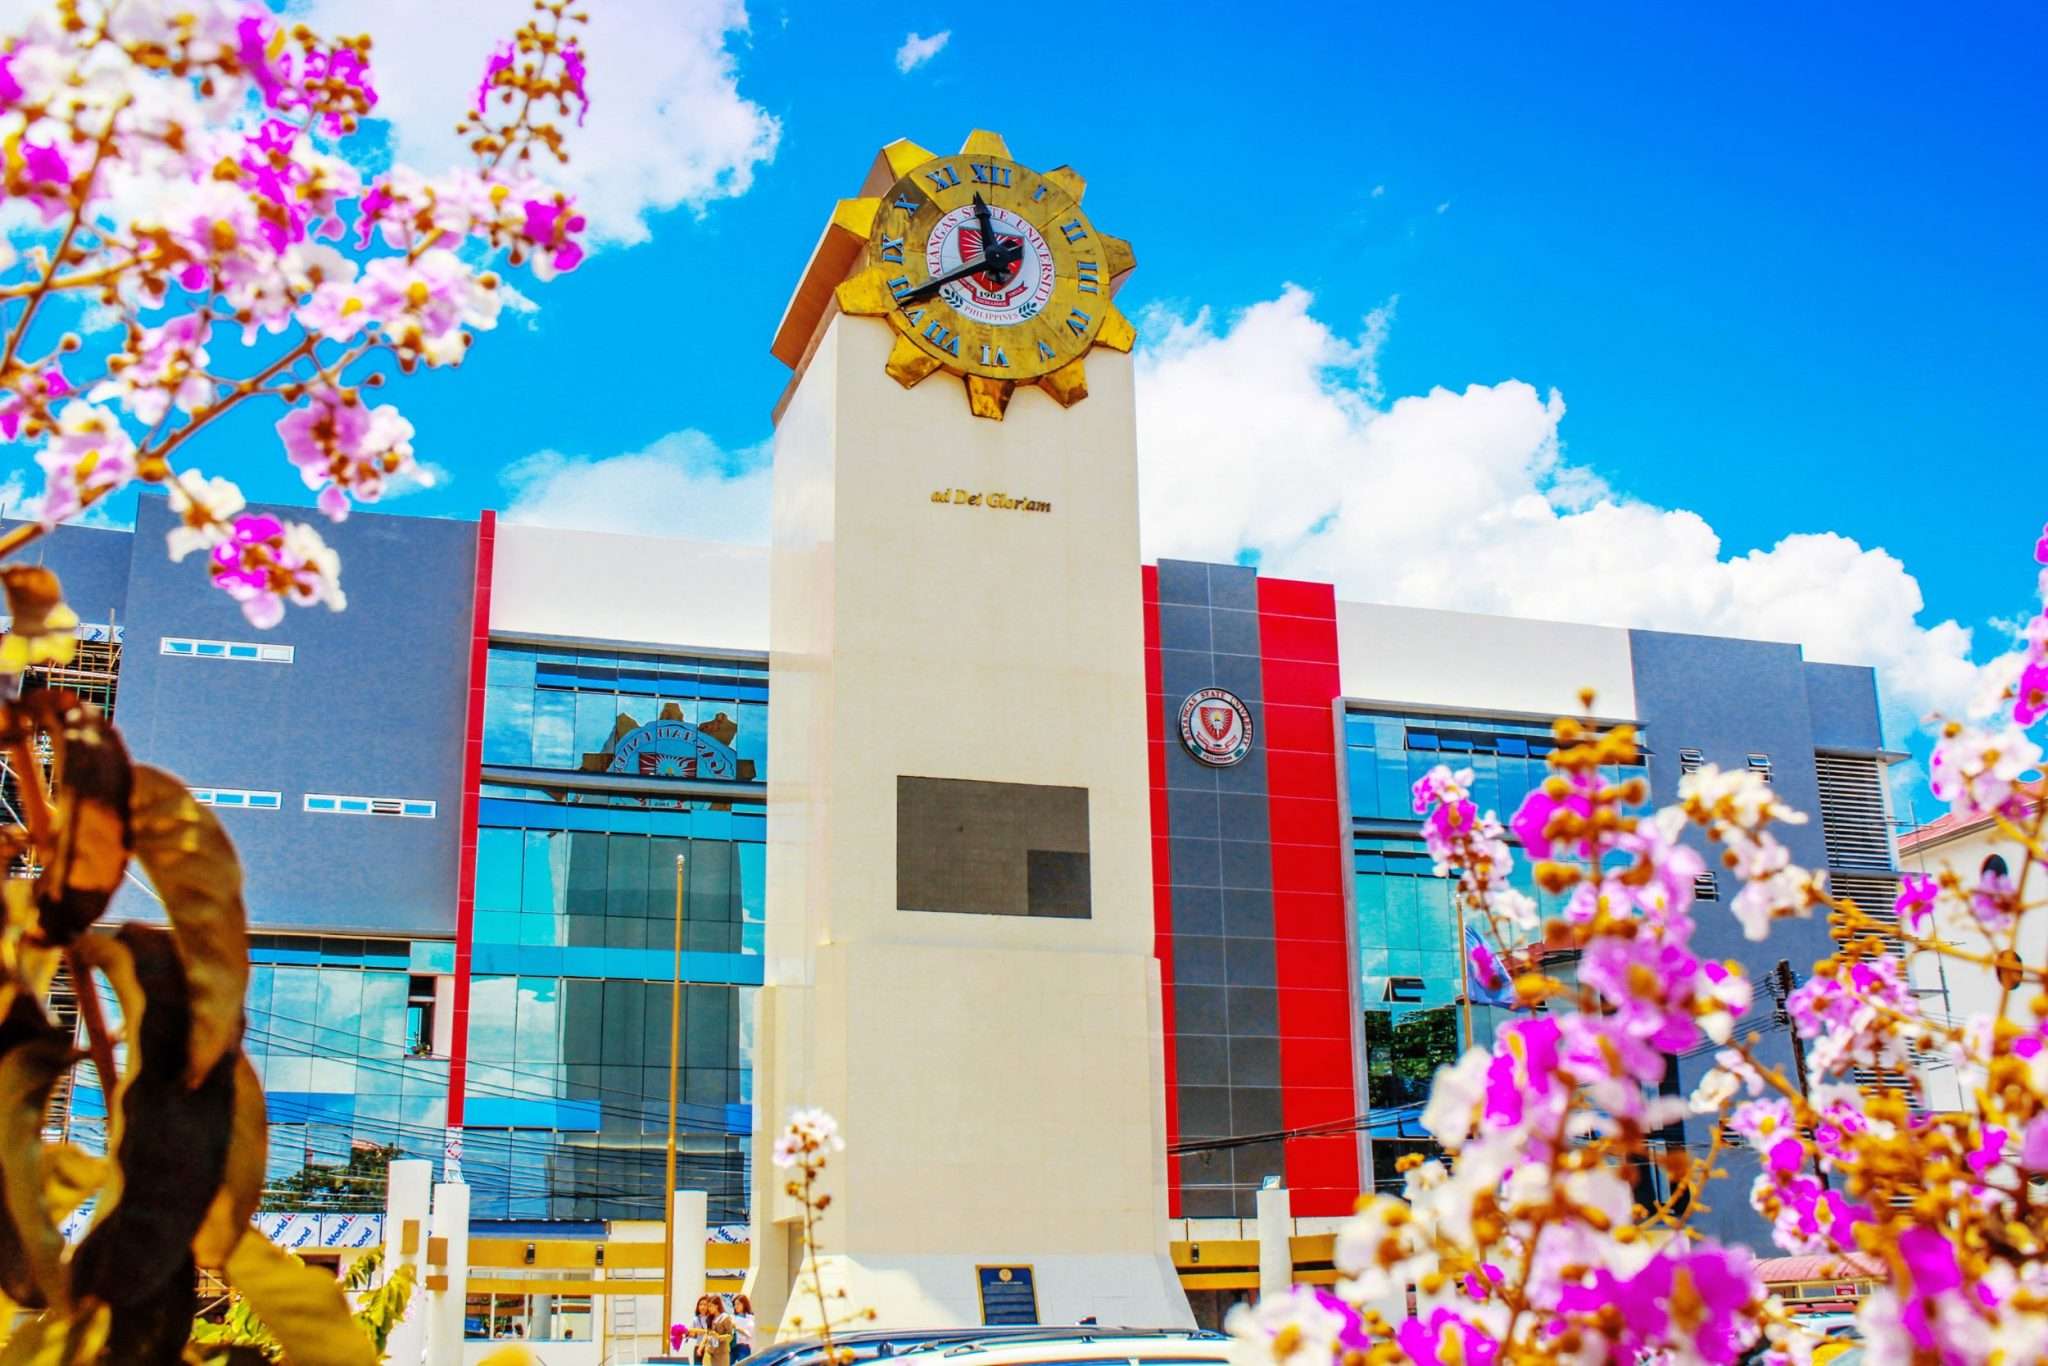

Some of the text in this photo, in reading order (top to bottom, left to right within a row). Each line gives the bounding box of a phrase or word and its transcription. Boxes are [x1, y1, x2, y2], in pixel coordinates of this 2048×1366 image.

[926, 165, 960, 192] XI
[970, 163, 1012, 188] XII
[894, 193, 920, 217] X
[1060, 218, 1088, 246] II
[881, 232, 905, 265] IX
[929, 213, 958, 277] ATANGAS
[1015, 219, 1052, 304] UNIVERSITY
[1077, 261, 1098, 295] III
[964, 305, 1019, 321] PHILIPPINES
[930, 488, 1051, 513] ad Dei Gloriam
[1200, 690, 1226, 699] STATE
[269, 1218, 288, 1241] orld
[325, 1218, 349, 1246] World
